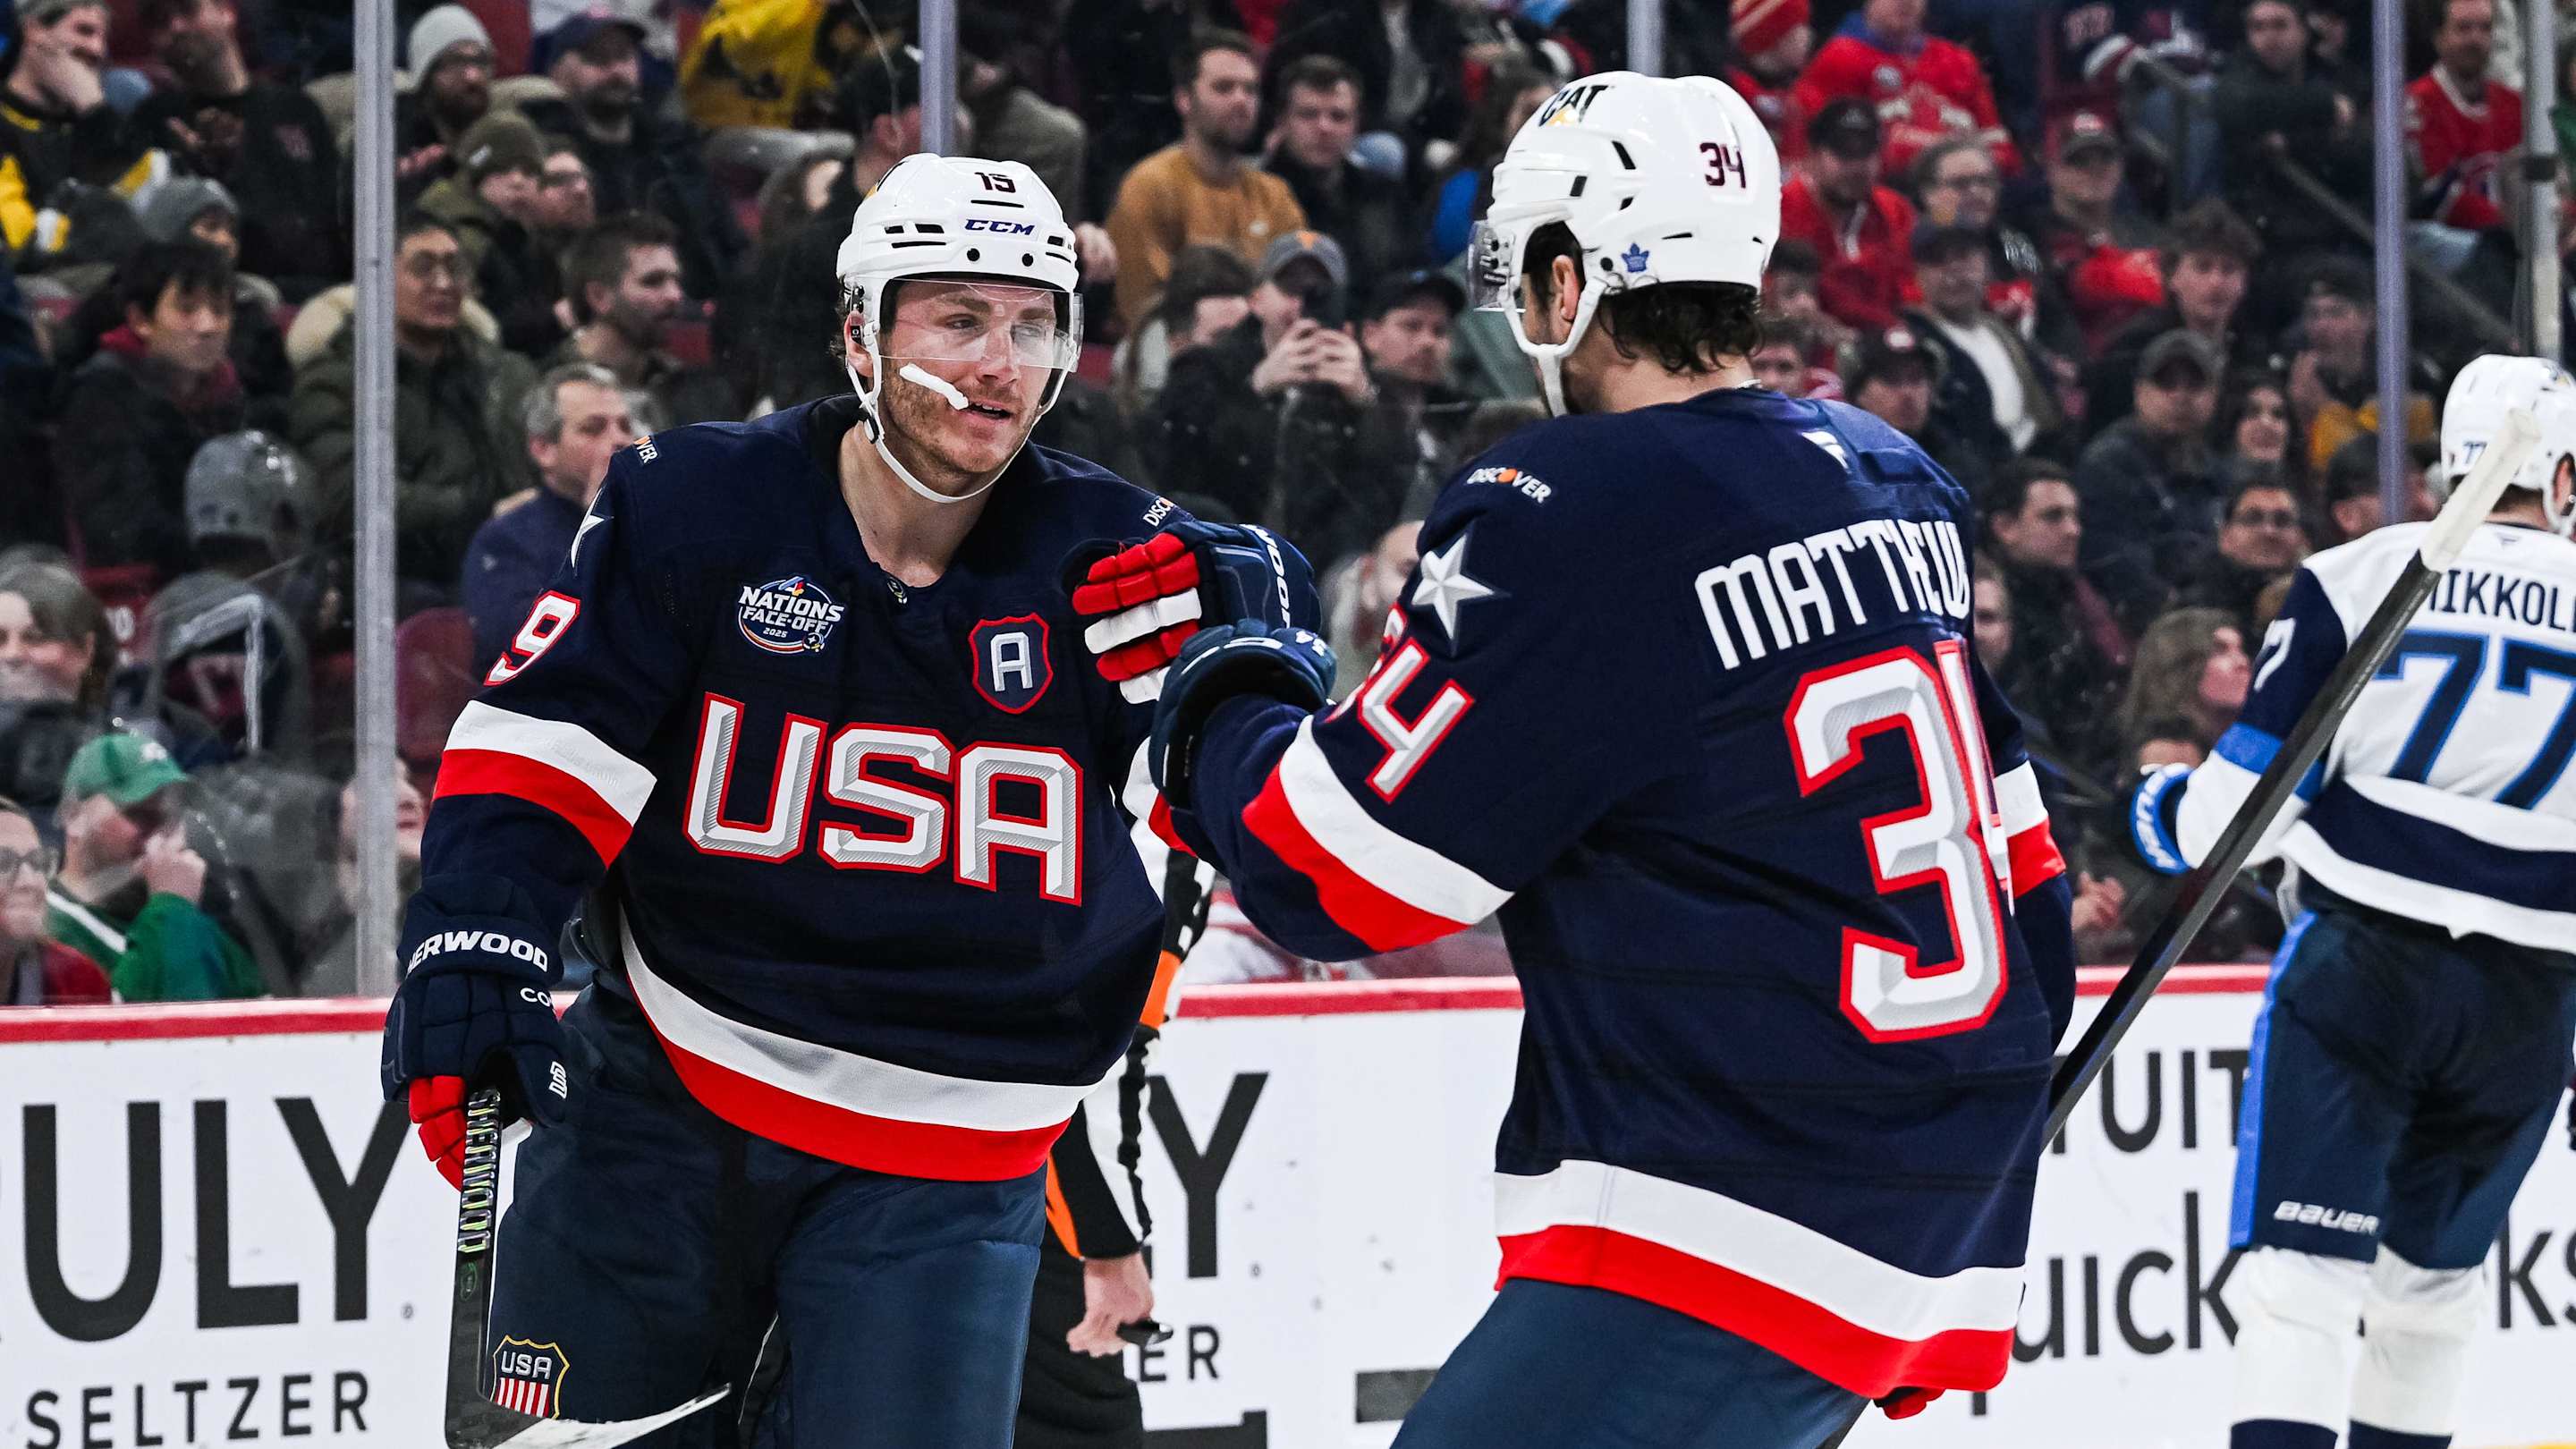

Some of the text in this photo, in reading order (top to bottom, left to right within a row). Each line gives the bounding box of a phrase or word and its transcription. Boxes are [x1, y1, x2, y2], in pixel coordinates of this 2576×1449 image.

[1539, 85, 1608, 126] CAT
[1699, 142, 1746, 189] 34
[965, 219, 1035, 235] CCM
[1467, 467, 1552, 503] DISCOVER
[1143, 496, 1174, 527] DISC
[739, 586, 844, 623] NATIONS
[1694, 518, 1970, 670] MATTHEW
[2428, 568, 2576, 634] IKKOL
[483, 589, 580, 687] 9
[742, 606, 829, 633] FACE-OFF
[763, 627, 788, 638] 2025
[990, 631, 1032, 691] A
[2375, 629, 2576, 810] 77
[682, 691, 1084, 907] USA
[405, 931, 548, 980] HERWOOD
[521, 987, 553, 1007] CO
[0, 1097, 411, 1343] ULY
[501, 1351, 553, 1379] USA
[25, 1370, 371, 1449] SELTZER
